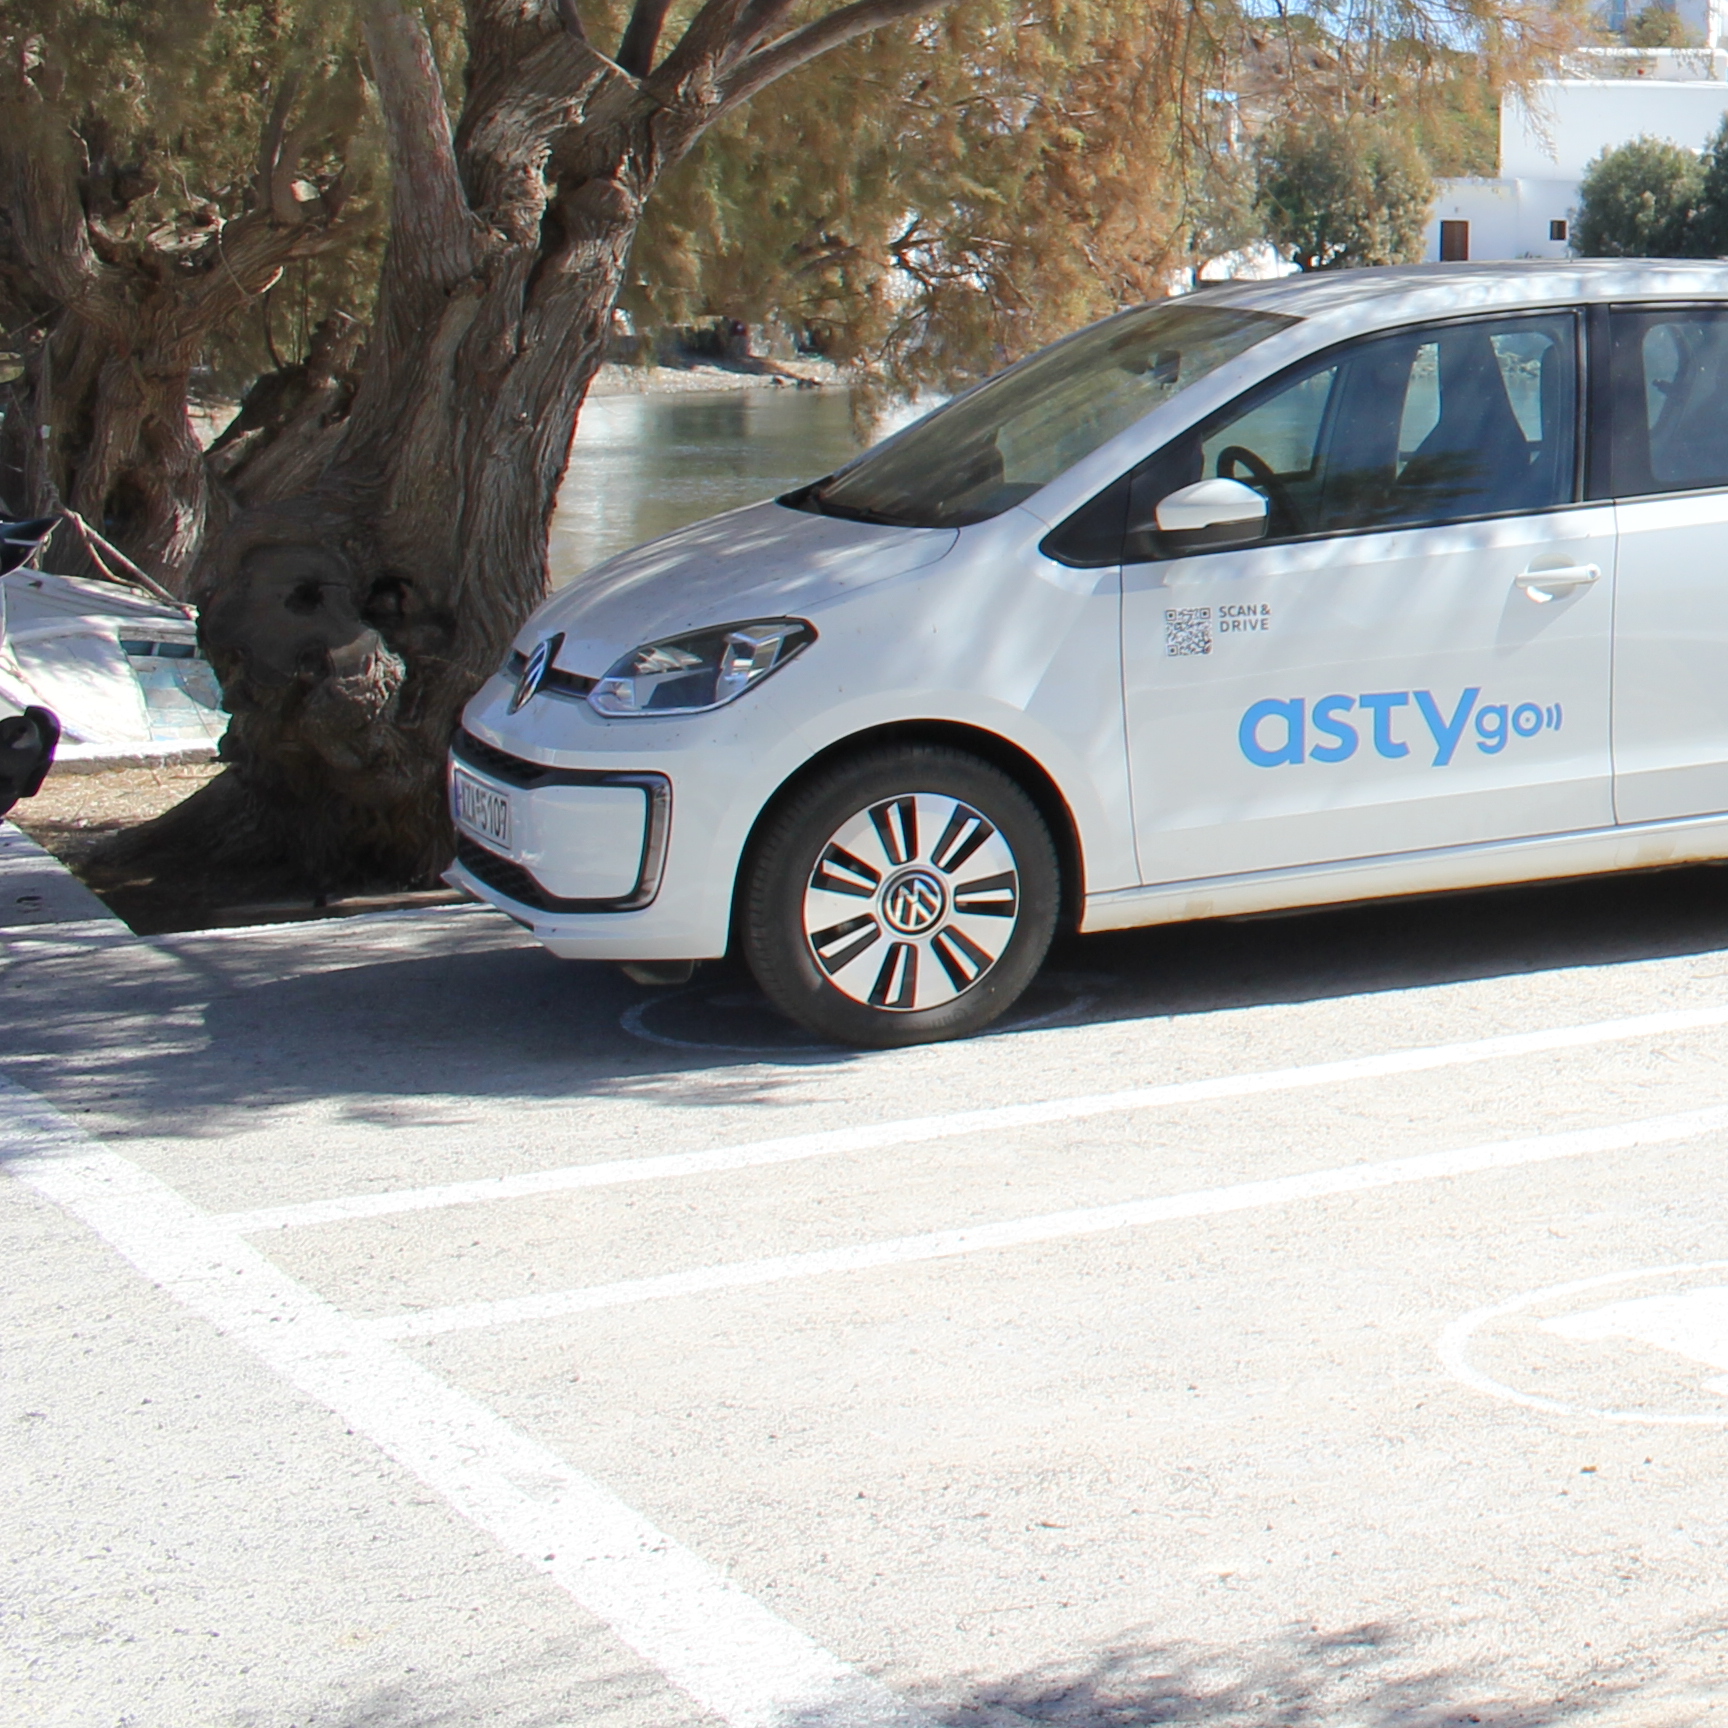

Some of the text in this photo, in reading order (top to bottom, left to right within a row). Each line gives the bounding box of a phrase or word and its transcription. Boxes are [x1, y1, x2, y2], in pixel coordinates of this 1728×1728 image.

[1218, 603, 1271, 618] SCAN &
[1219, 618, 1269, 633] DRIVE
